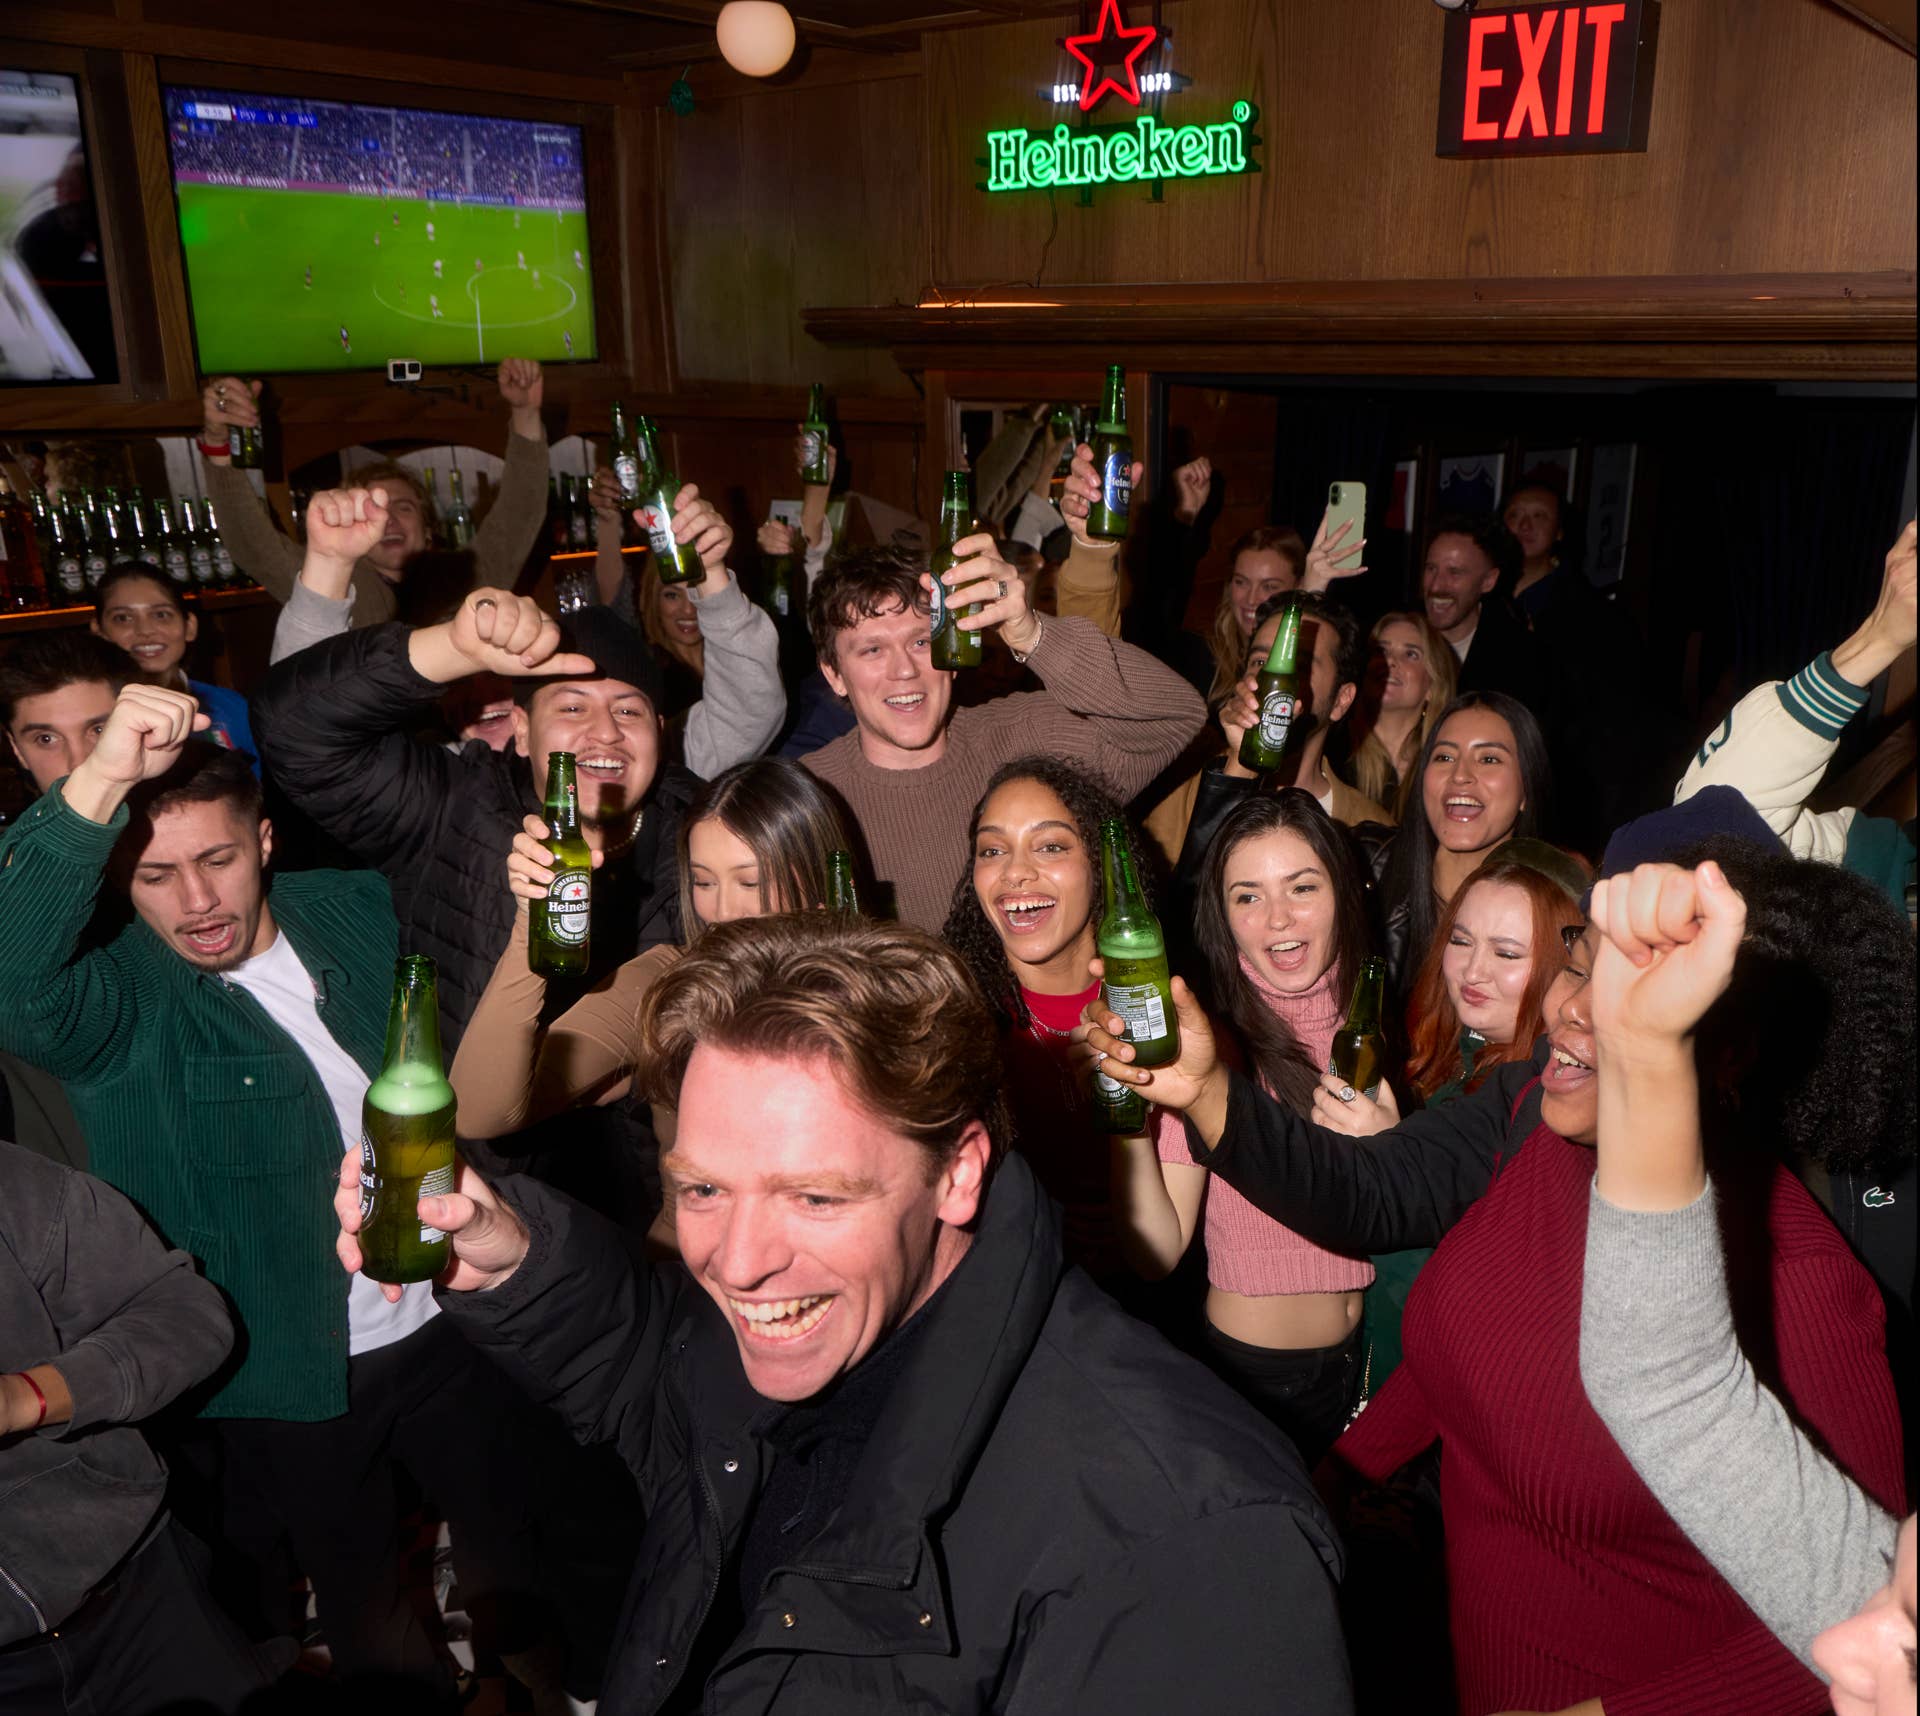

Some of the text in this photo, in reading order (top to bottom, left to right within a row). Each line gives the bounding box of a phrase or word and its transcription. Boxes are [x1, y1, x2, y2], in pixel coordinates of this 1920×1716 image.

[1463, 4, 1626, 141] EXIT
[1053, 72, 1171, 102] EST. 1873
[207, 173, 288, 189] QATAR AIRWAYS
[387, 187, 419, 198] IRWAYS
[568, 794, 576, 828] Heineken
[553, 875, 578, 896] HEINEKEN
